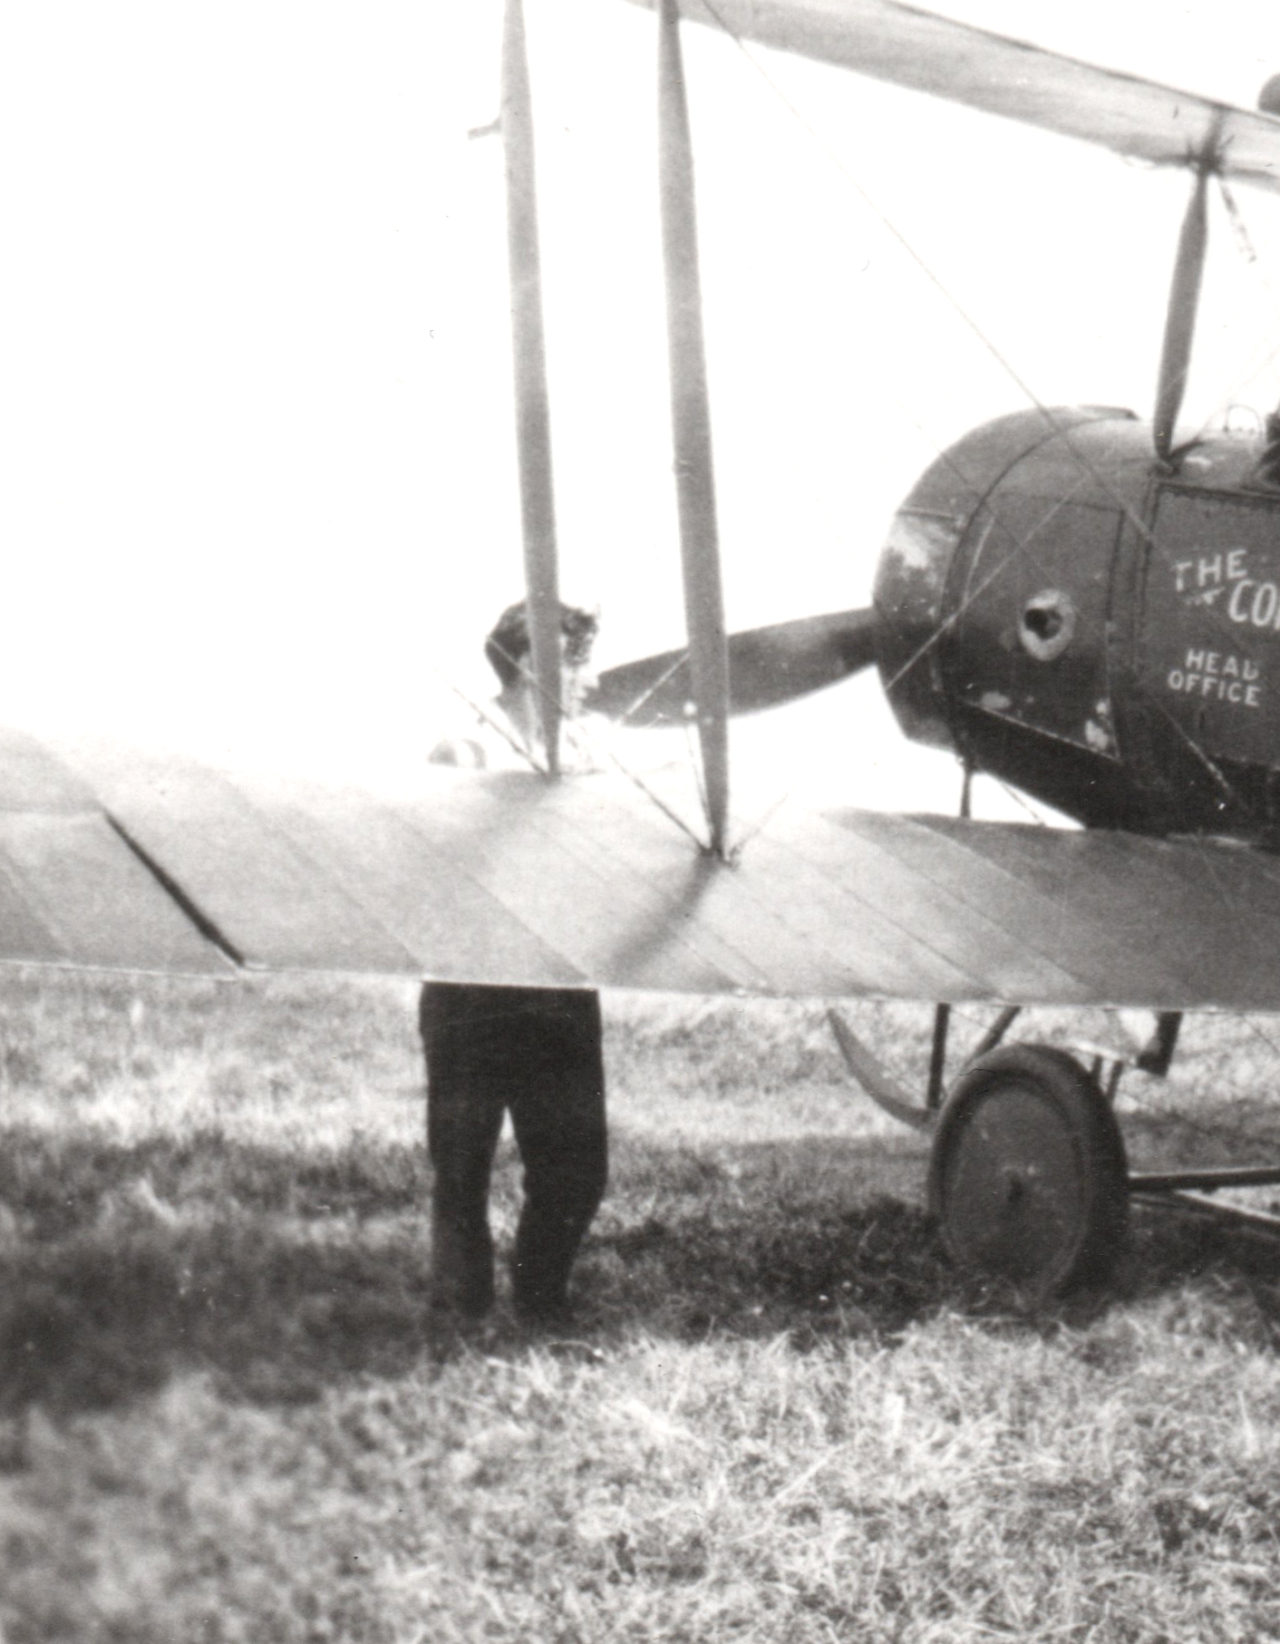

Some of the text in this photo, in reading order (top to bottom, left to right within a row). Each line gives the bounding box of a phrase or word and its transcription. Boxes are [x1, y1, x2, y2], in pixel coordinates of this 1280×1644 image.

[1172, 549, 1248, 592] THE
[1185, 648, 1260, 681] HEAD
[1168, 669, 1262, 708] OFFICE
